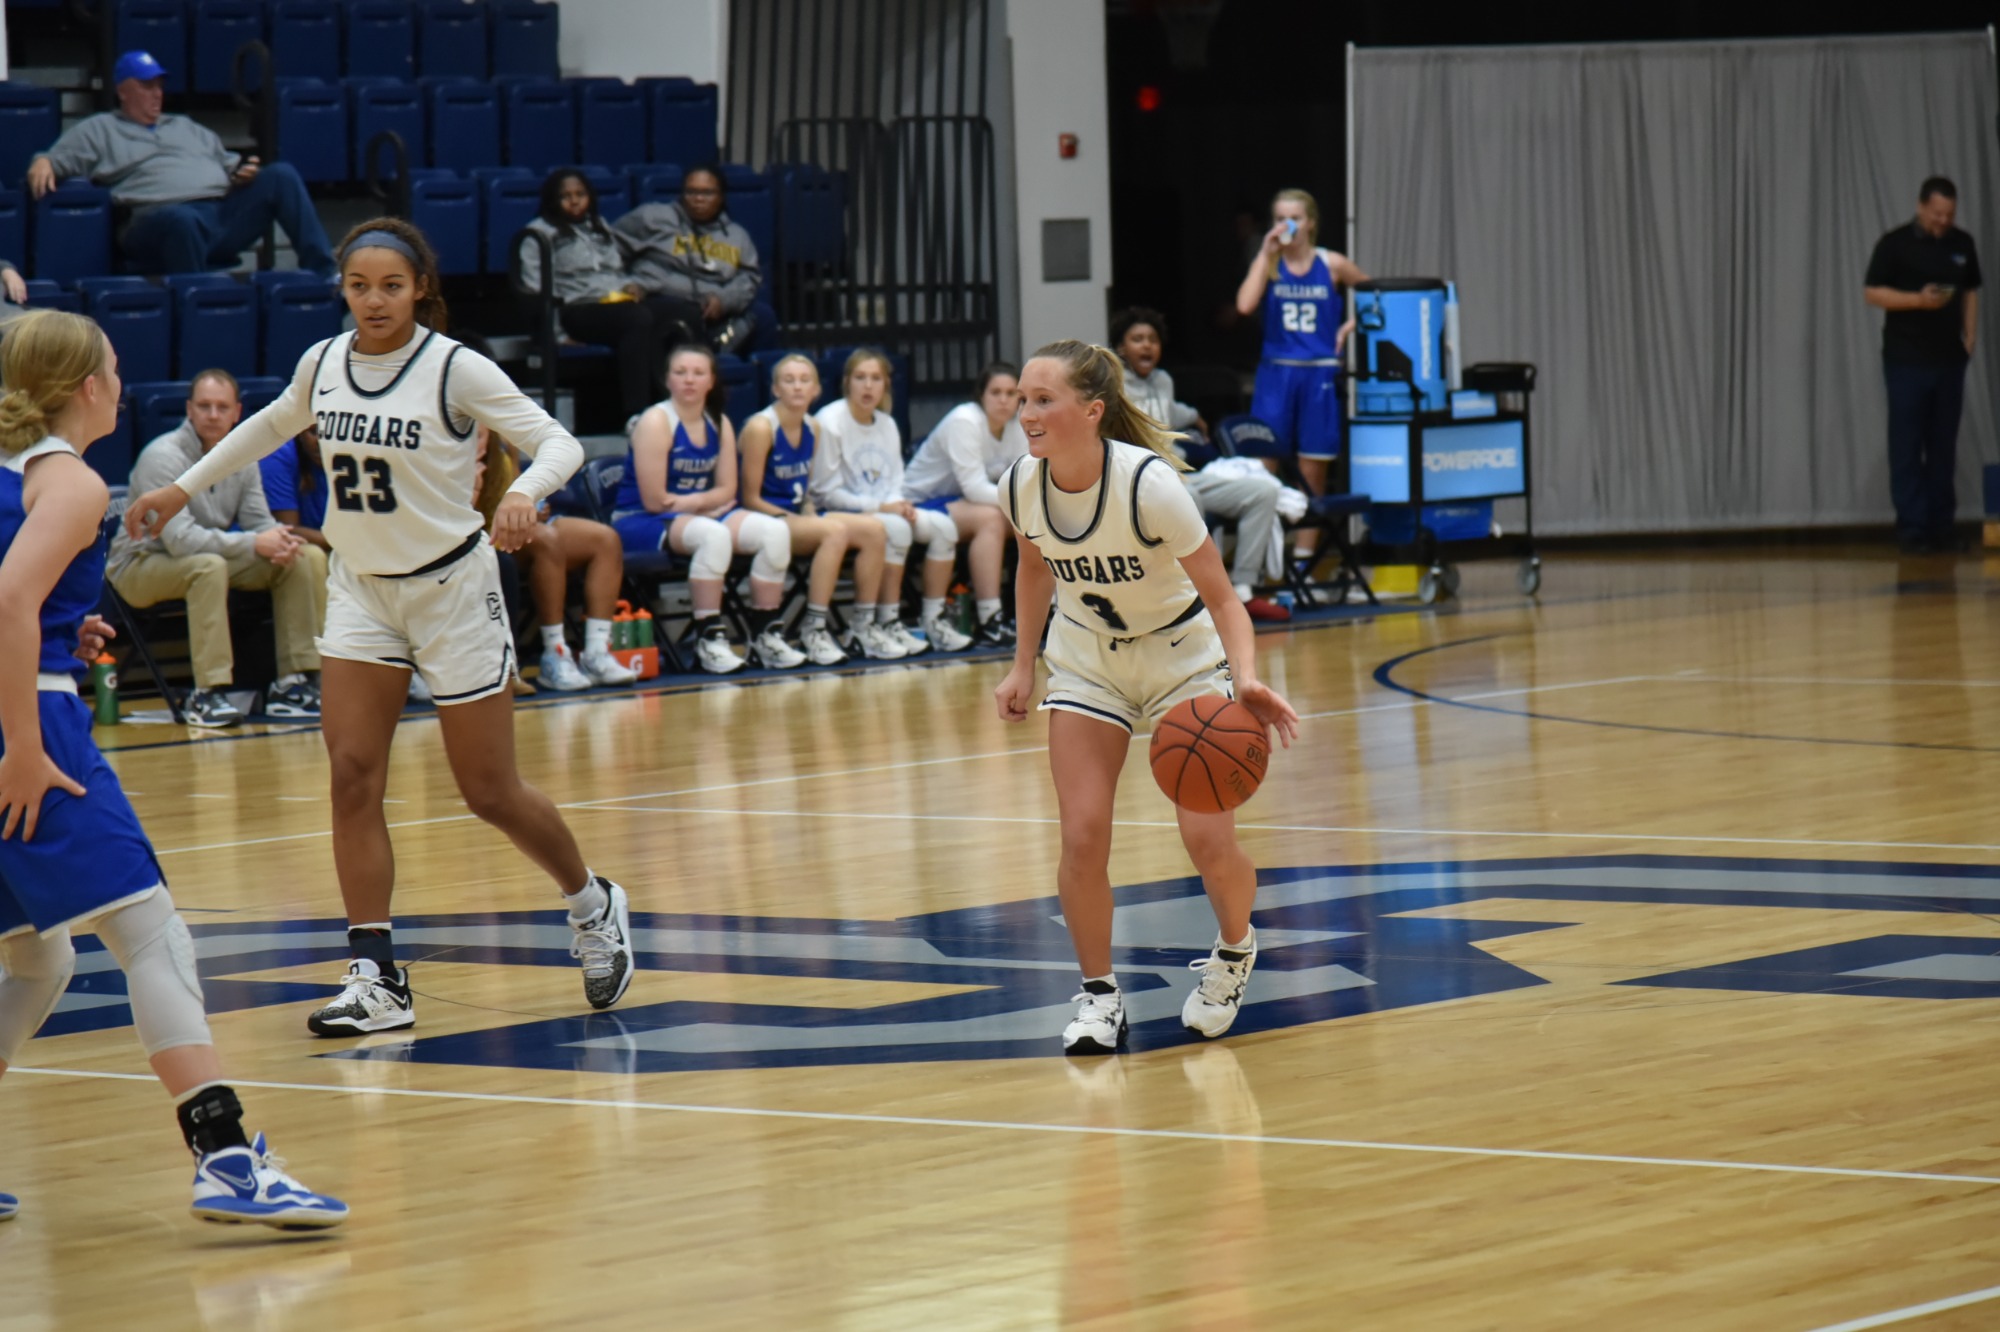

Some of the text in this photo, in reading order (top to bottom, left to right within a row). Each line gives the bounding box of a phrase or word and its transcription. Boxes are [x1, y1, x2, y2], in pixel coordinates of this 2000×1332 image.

[1282, 301, 1317, 333] 22
[315, 410, 422, 451] COUGARS
[332, 453, 398, 514] 23
[1042, 554, 1146, 585] OUGARS
[1080, 591, 1129, 632] 3
[629, 654, 643, 675] G
